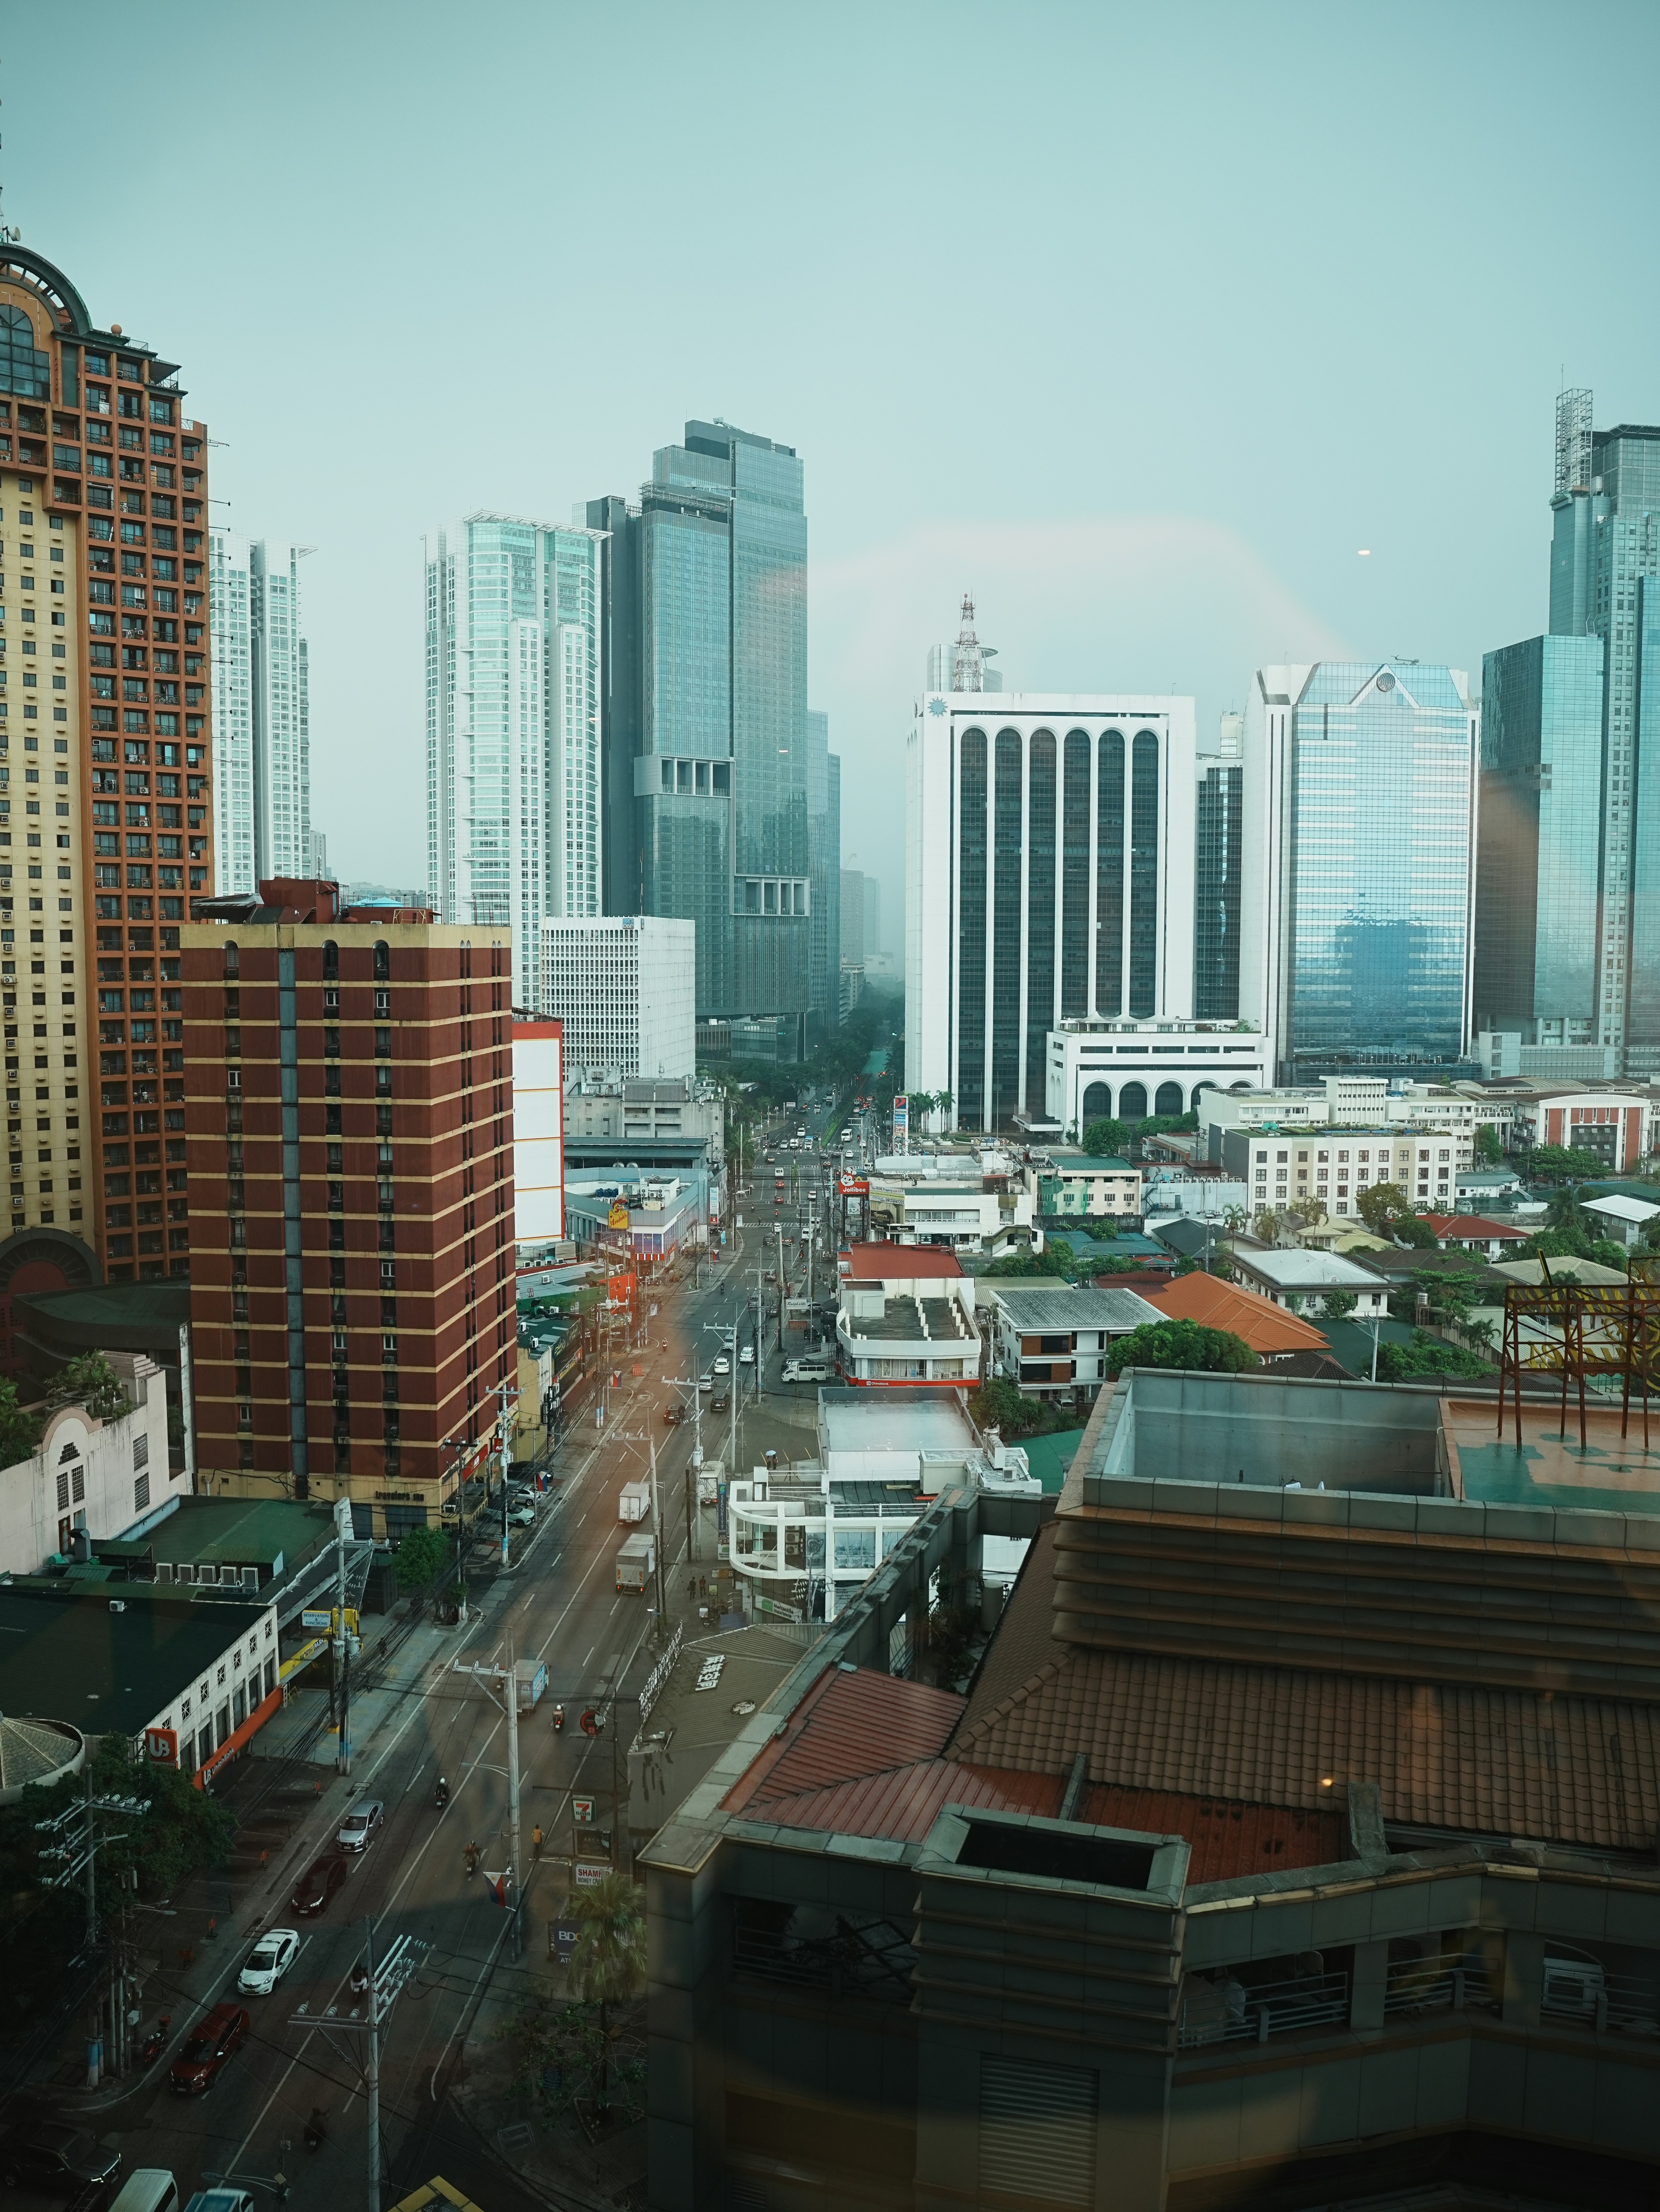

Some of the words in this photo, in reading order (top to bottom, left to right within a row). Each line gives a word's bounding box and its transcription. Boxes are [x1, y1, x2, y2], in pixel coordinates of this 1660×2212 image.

[609, 1213, 627, 1228] Andok's
[375, 1491, 410, 1500] travelers
[774, 1604, 794, 1614] Mercantile
[774, 1608, 792, 1618] Insurance
[300, 1647, 313, 1660] NORTH
[313, 1638, 325, 1650] PARK
[695, 1655, 726, 1691] 麻辣空间
[149, 1734, 170, 1757] UB
[212, 1746, 235, 1775] UnionBank
[576, 1803, 589, 1821] 7
[558, 1931, 583, 1942] BDO
